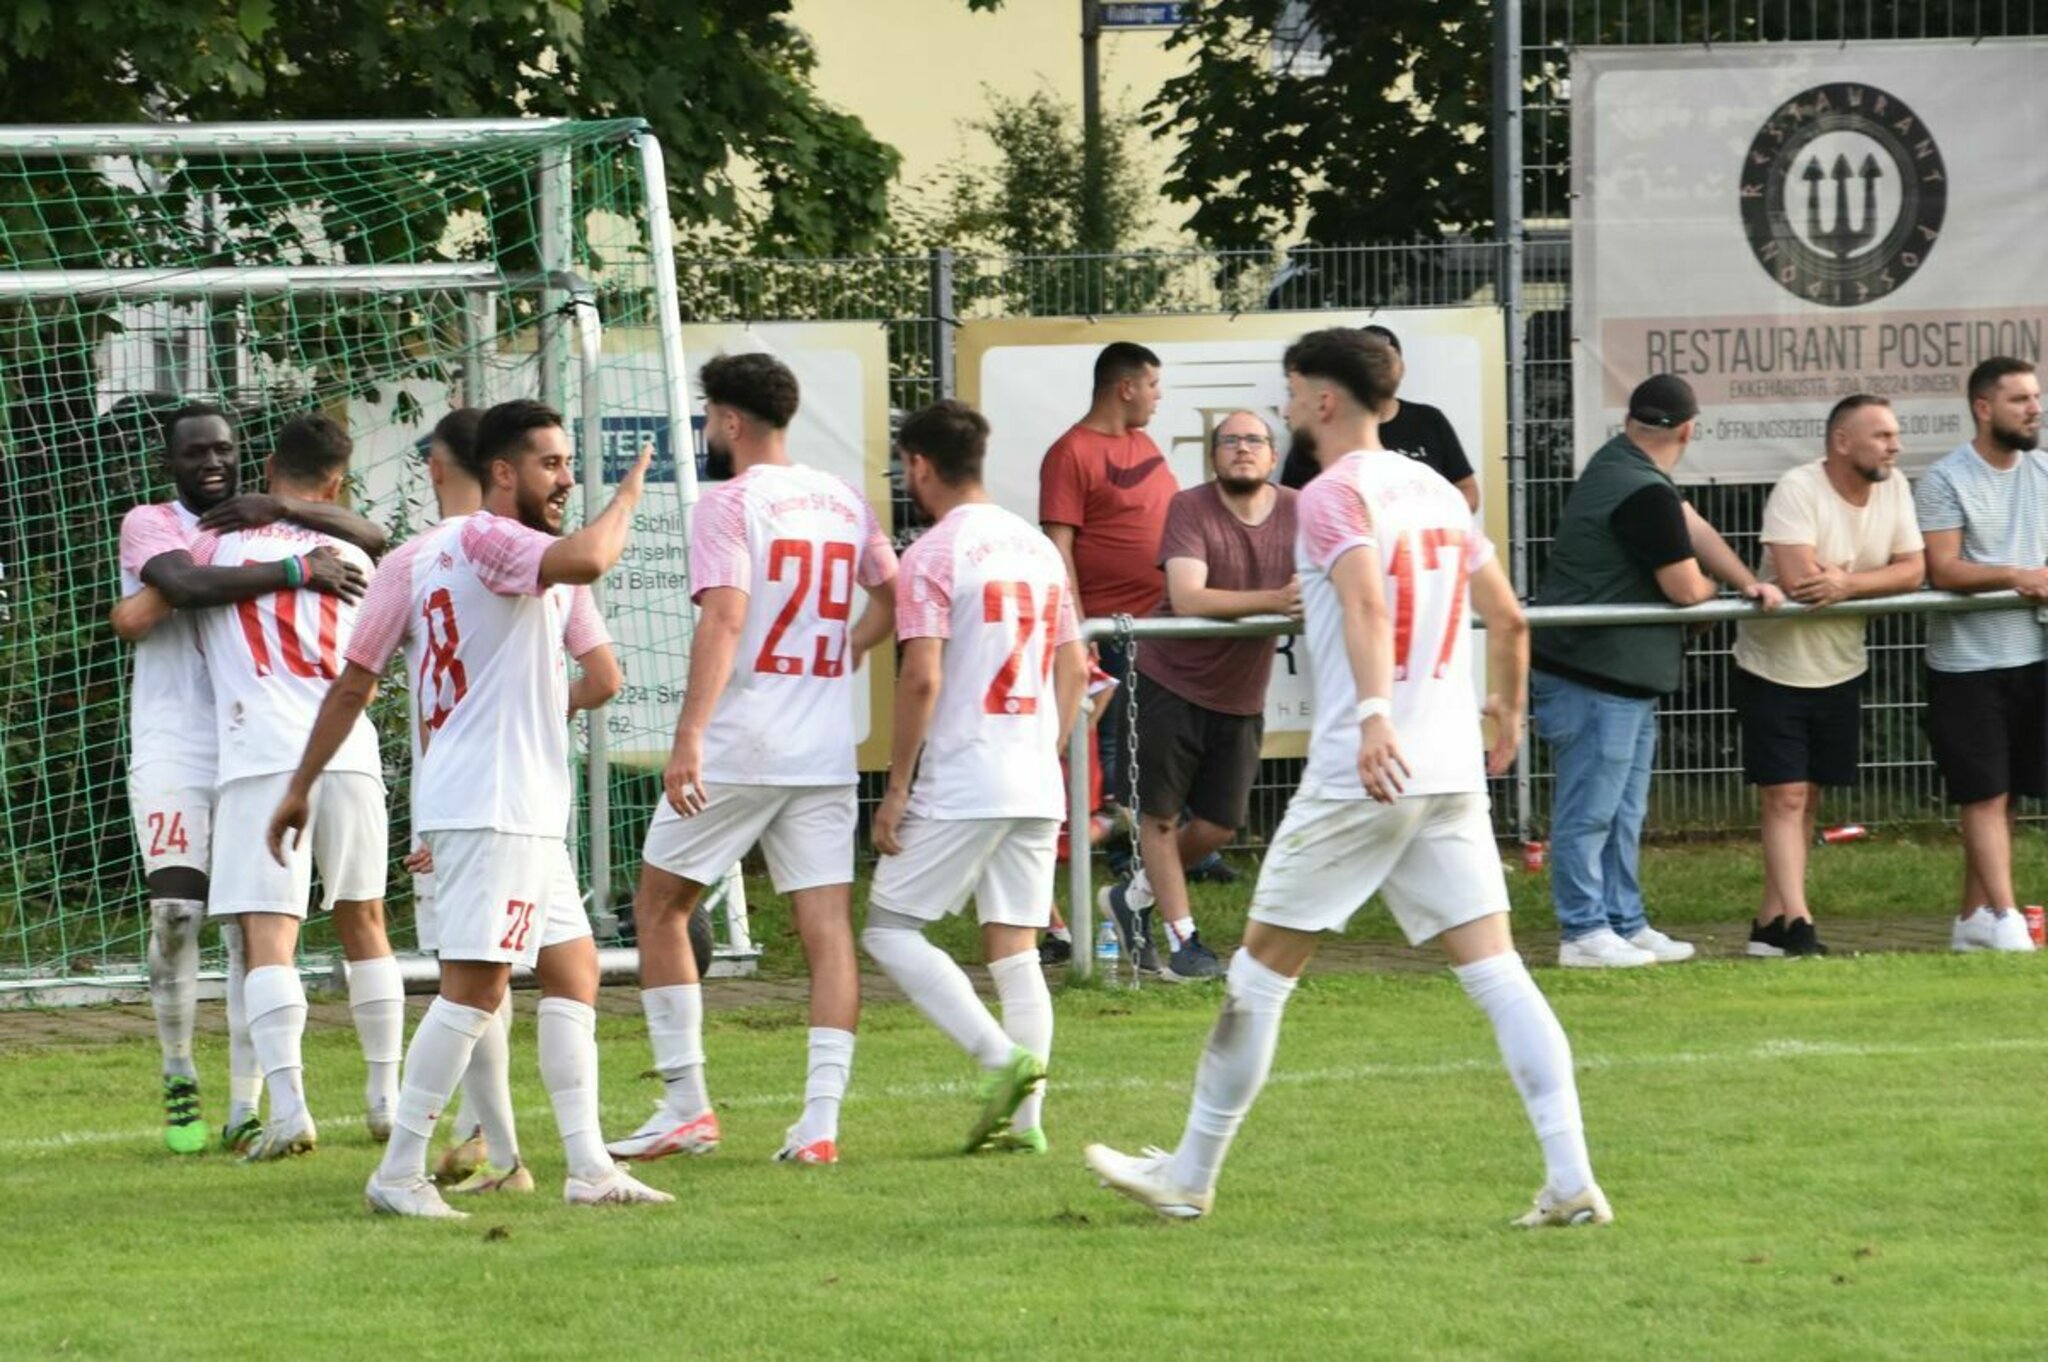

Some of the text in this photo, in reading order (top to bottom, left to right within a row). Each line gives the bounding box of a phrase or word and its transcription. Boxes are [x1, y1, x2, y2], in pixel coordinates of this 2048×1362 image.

[1740, 86, 1943, 198] RESTAURANT
[1761, 224, 1938, 301] POSEIDON
[1646, 319, 2042, 375] RESTAURANT POSEIDON
[601, 429, 658, 456] TER
[1717, 418, 1828, 440] ÖFFNUNGSZEITE
[1896, 413, 1929, 435] 5.00
[1932, 413, 1960, 434] UHR
[620, 543, 682, 561] chseln
[629, 571, 686, 590] Batter
[754, 538, 857, 679] 29
[1387, 528, 1473, 682] 17
[616, 684, 686, 705] 224 Sin
[148, 811, 188, 857] 24
